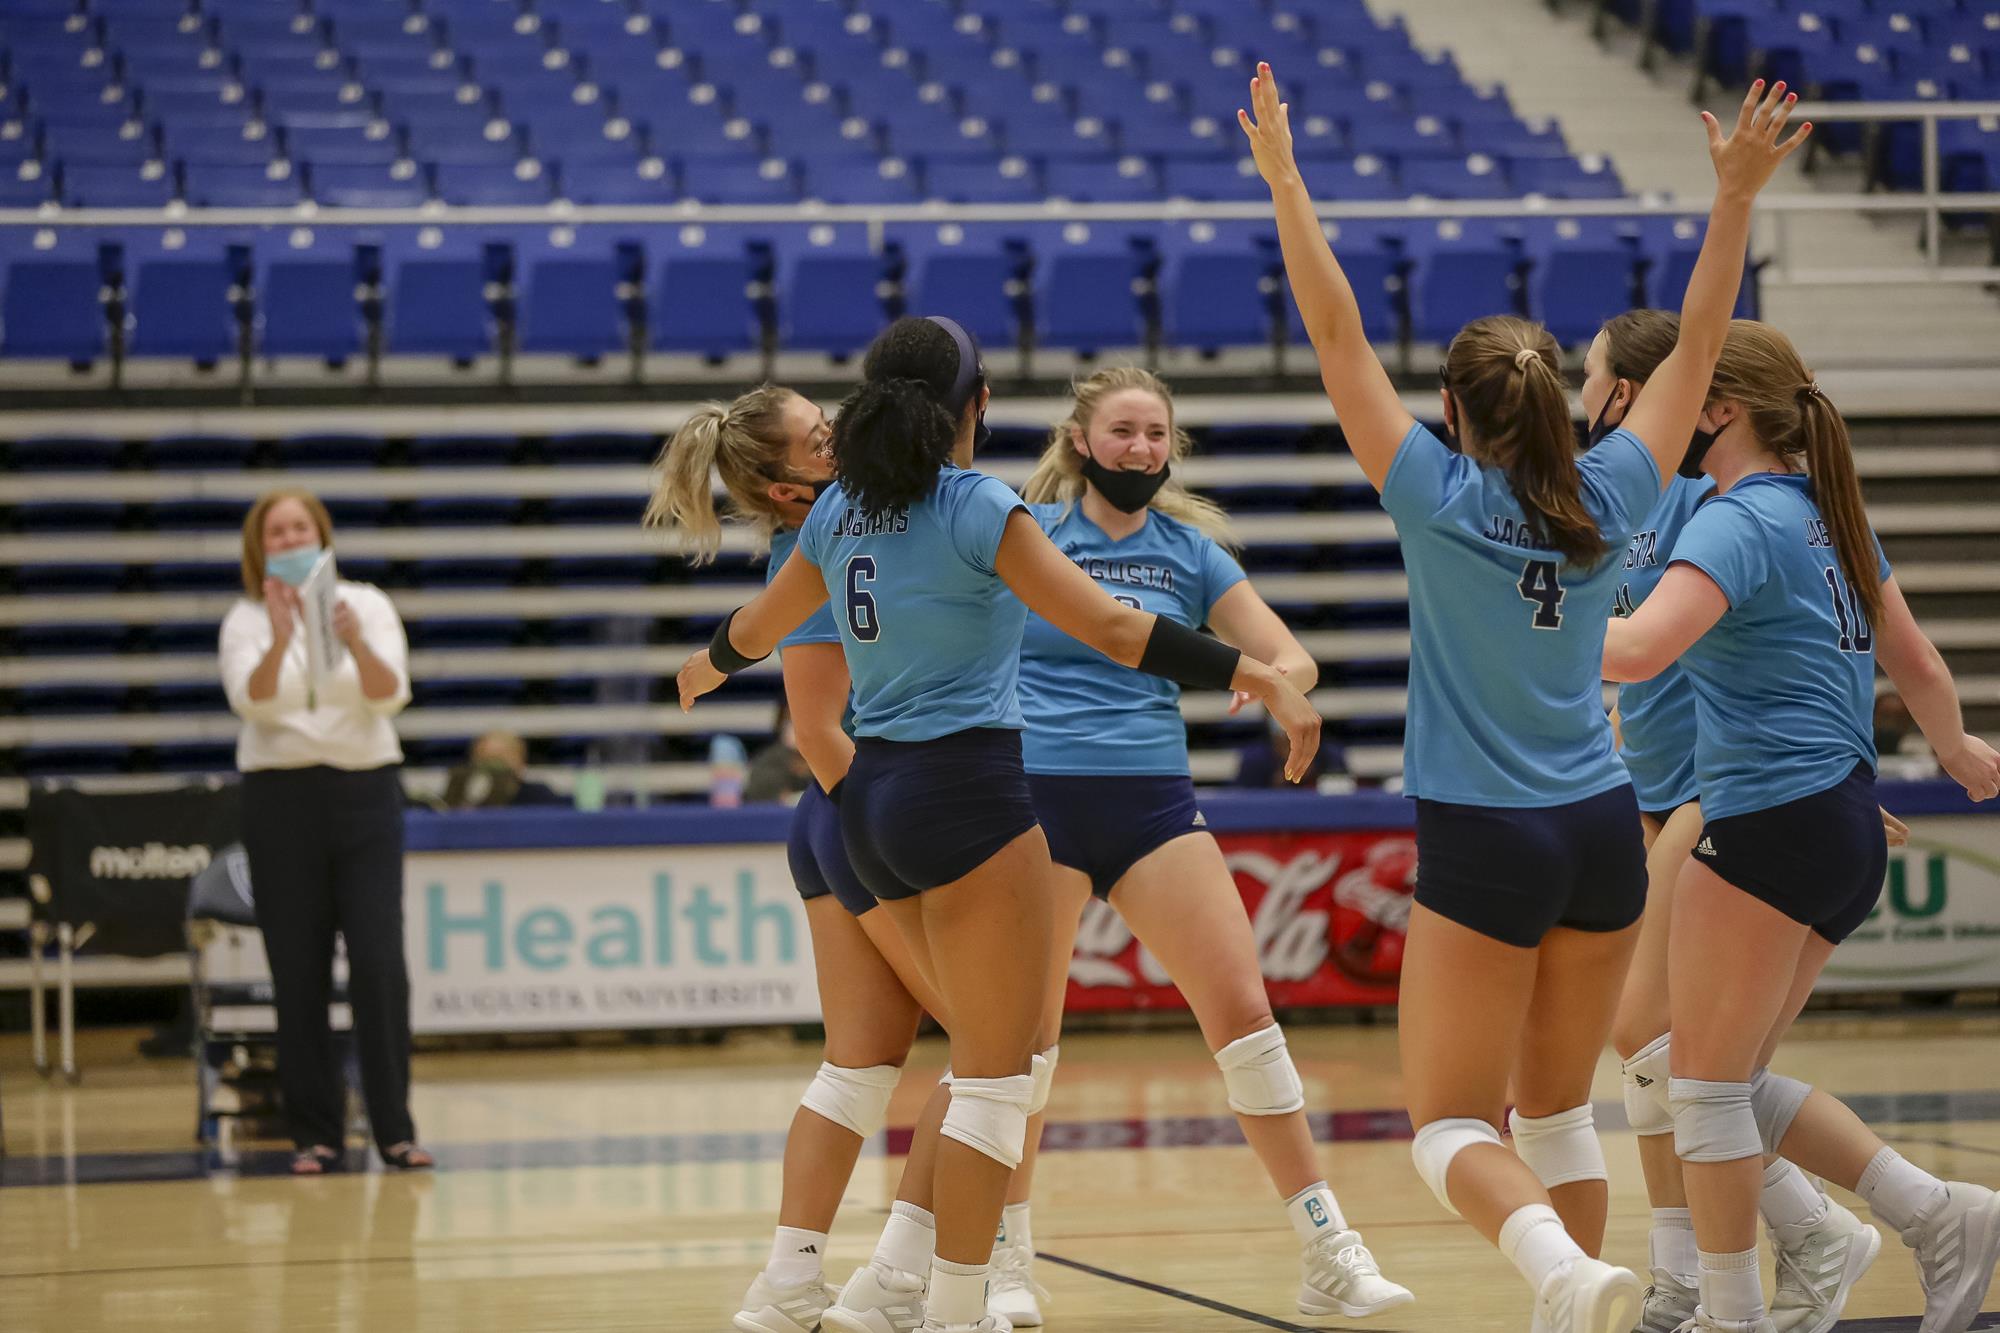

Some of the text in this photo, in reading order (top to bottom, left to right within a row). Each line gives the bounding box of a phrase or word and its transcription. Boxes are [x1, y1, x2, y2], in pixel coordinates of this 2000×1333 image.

[845, 555, 881, 643] 6
[1516, 559, 1567, 631] 4
[1824, 566, 1872, 654] 10
[90, 841, 211, 880] molten
[1867, 852, 1947, 920] U
[425, 869, 799, 974] Health
[431, 977, 799, 1017] AUGUSTA UNIVERSITY
